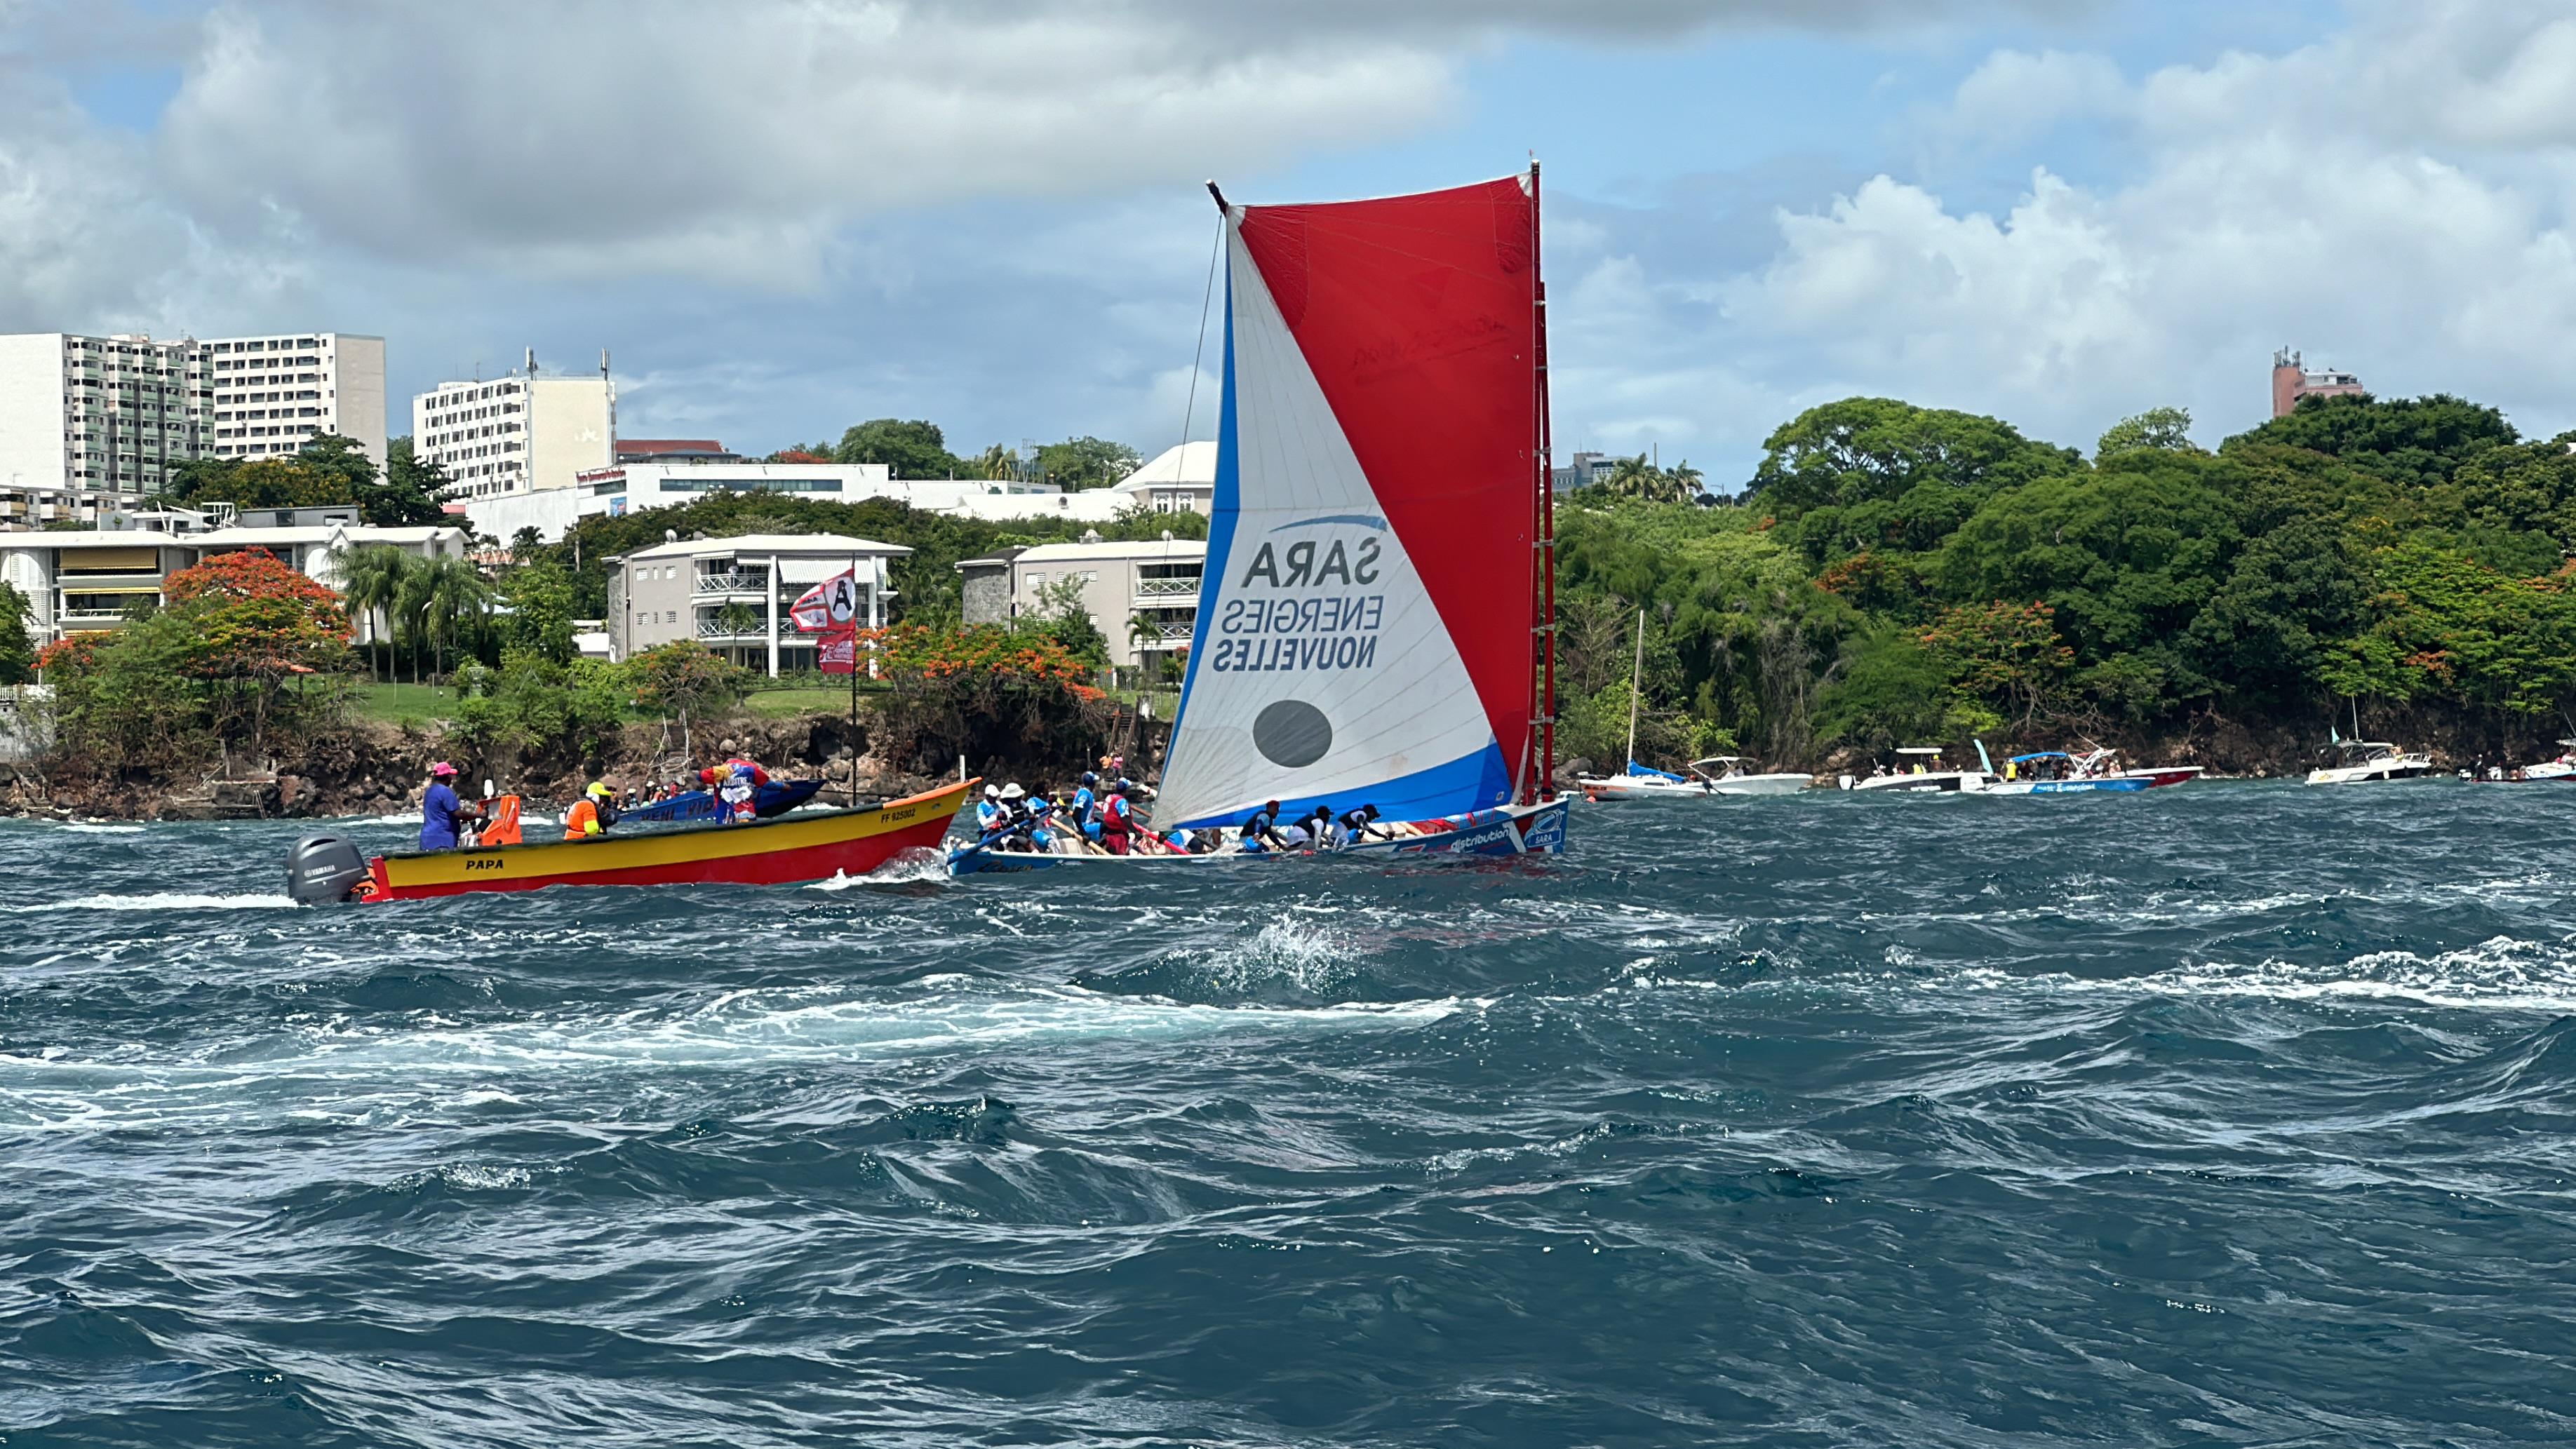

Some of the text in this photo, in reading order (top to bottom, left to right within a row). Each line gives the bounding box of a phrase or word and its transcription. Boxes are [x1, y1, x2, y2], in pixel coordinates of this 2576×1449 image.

[881, 814, 890, 824] FF
[1450, 828, 1509, 851] distribution
[1535, 833, 1552, 844] SARA
[311, 864, 336, 876] YAMAHA
[466, 859, 504, 870] PAPA
